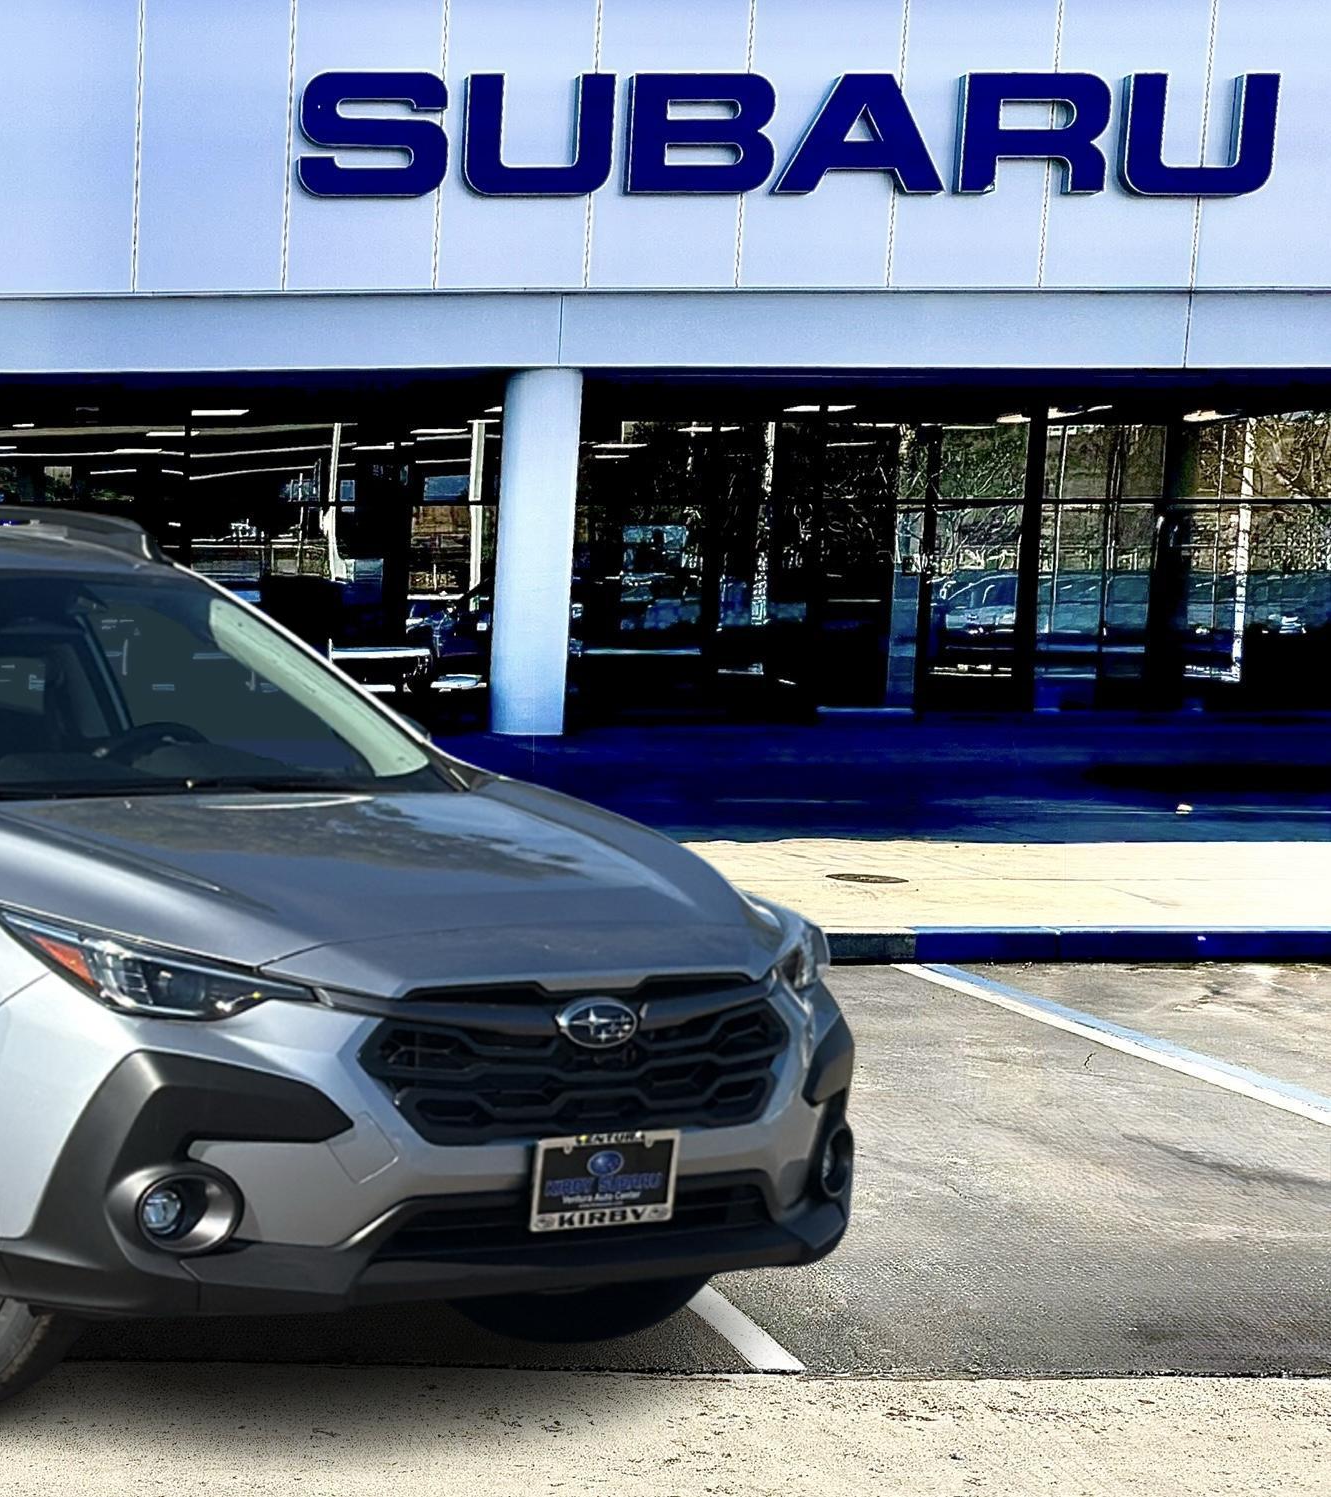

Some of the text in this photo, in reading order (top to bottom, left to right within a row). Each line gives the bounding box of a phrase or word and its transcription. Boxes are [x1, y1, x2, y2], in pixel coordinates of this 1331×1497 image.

[296, 69, 1282, 198] SUBARU
[562, 1190, 641, 1204] Ventura Auto Center
[557, 1207, 647, 1228] KIRBY
